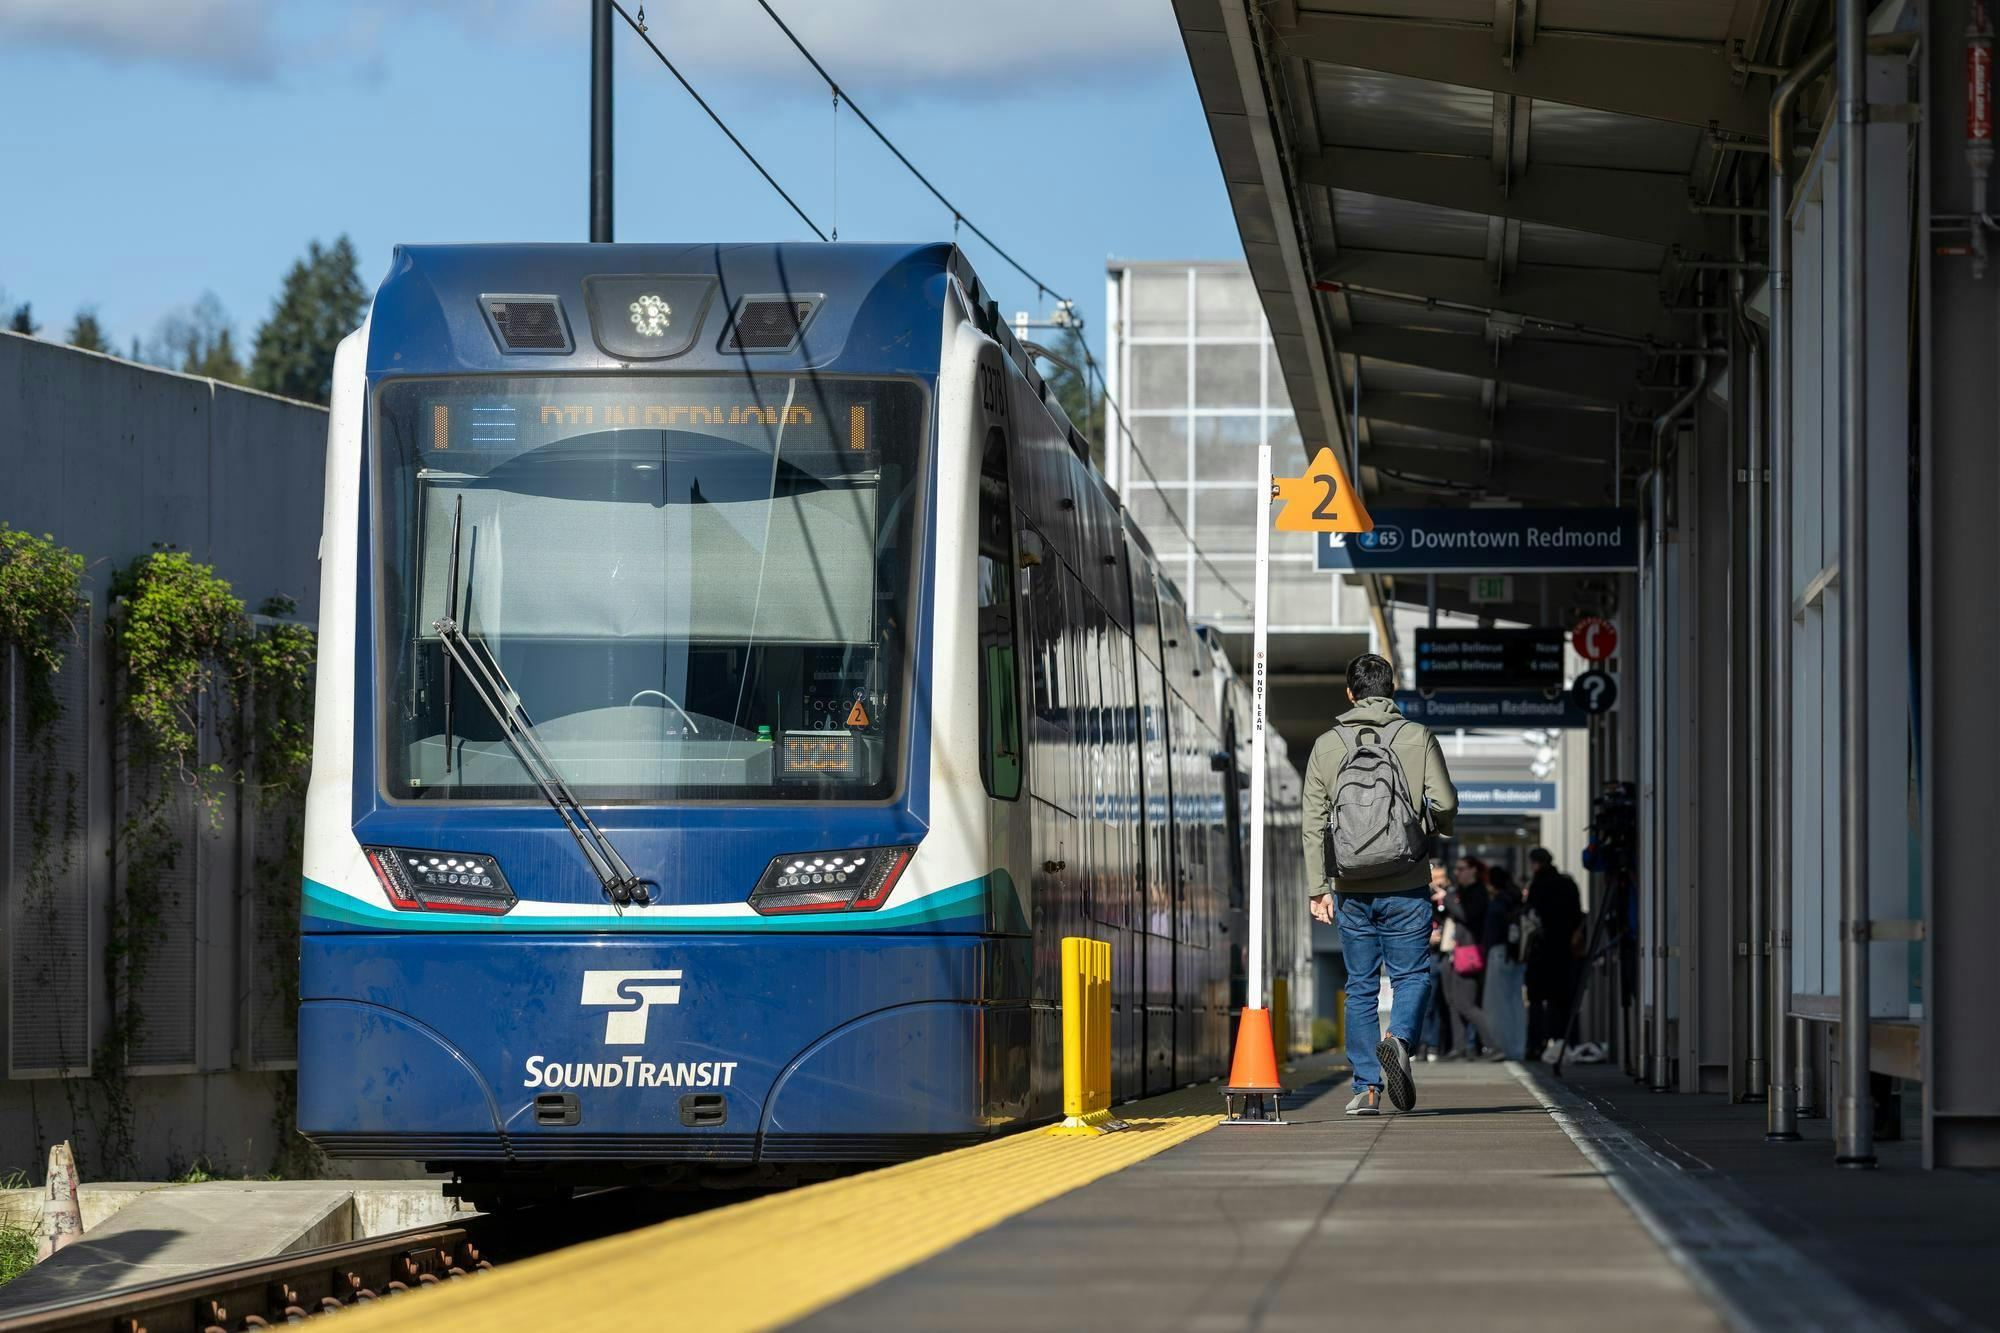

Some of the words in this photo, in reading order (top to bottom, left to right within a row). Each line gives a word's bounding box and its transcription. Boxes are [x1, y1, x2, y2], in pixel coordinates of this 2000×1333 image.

[1312, 474, 1338, 520] 2
[1379, 532, 1397, 546] 65
[1411, 528, 1520, 548] Downtown
[1527, 526, 1621, 547] Redmond
[1257, 662, 1263, 676] DO
[854, 708, 862, 722] 2
[1426, 700, 1499, 716] Downtown
[1501, 700, 1565, 716] Redmond
